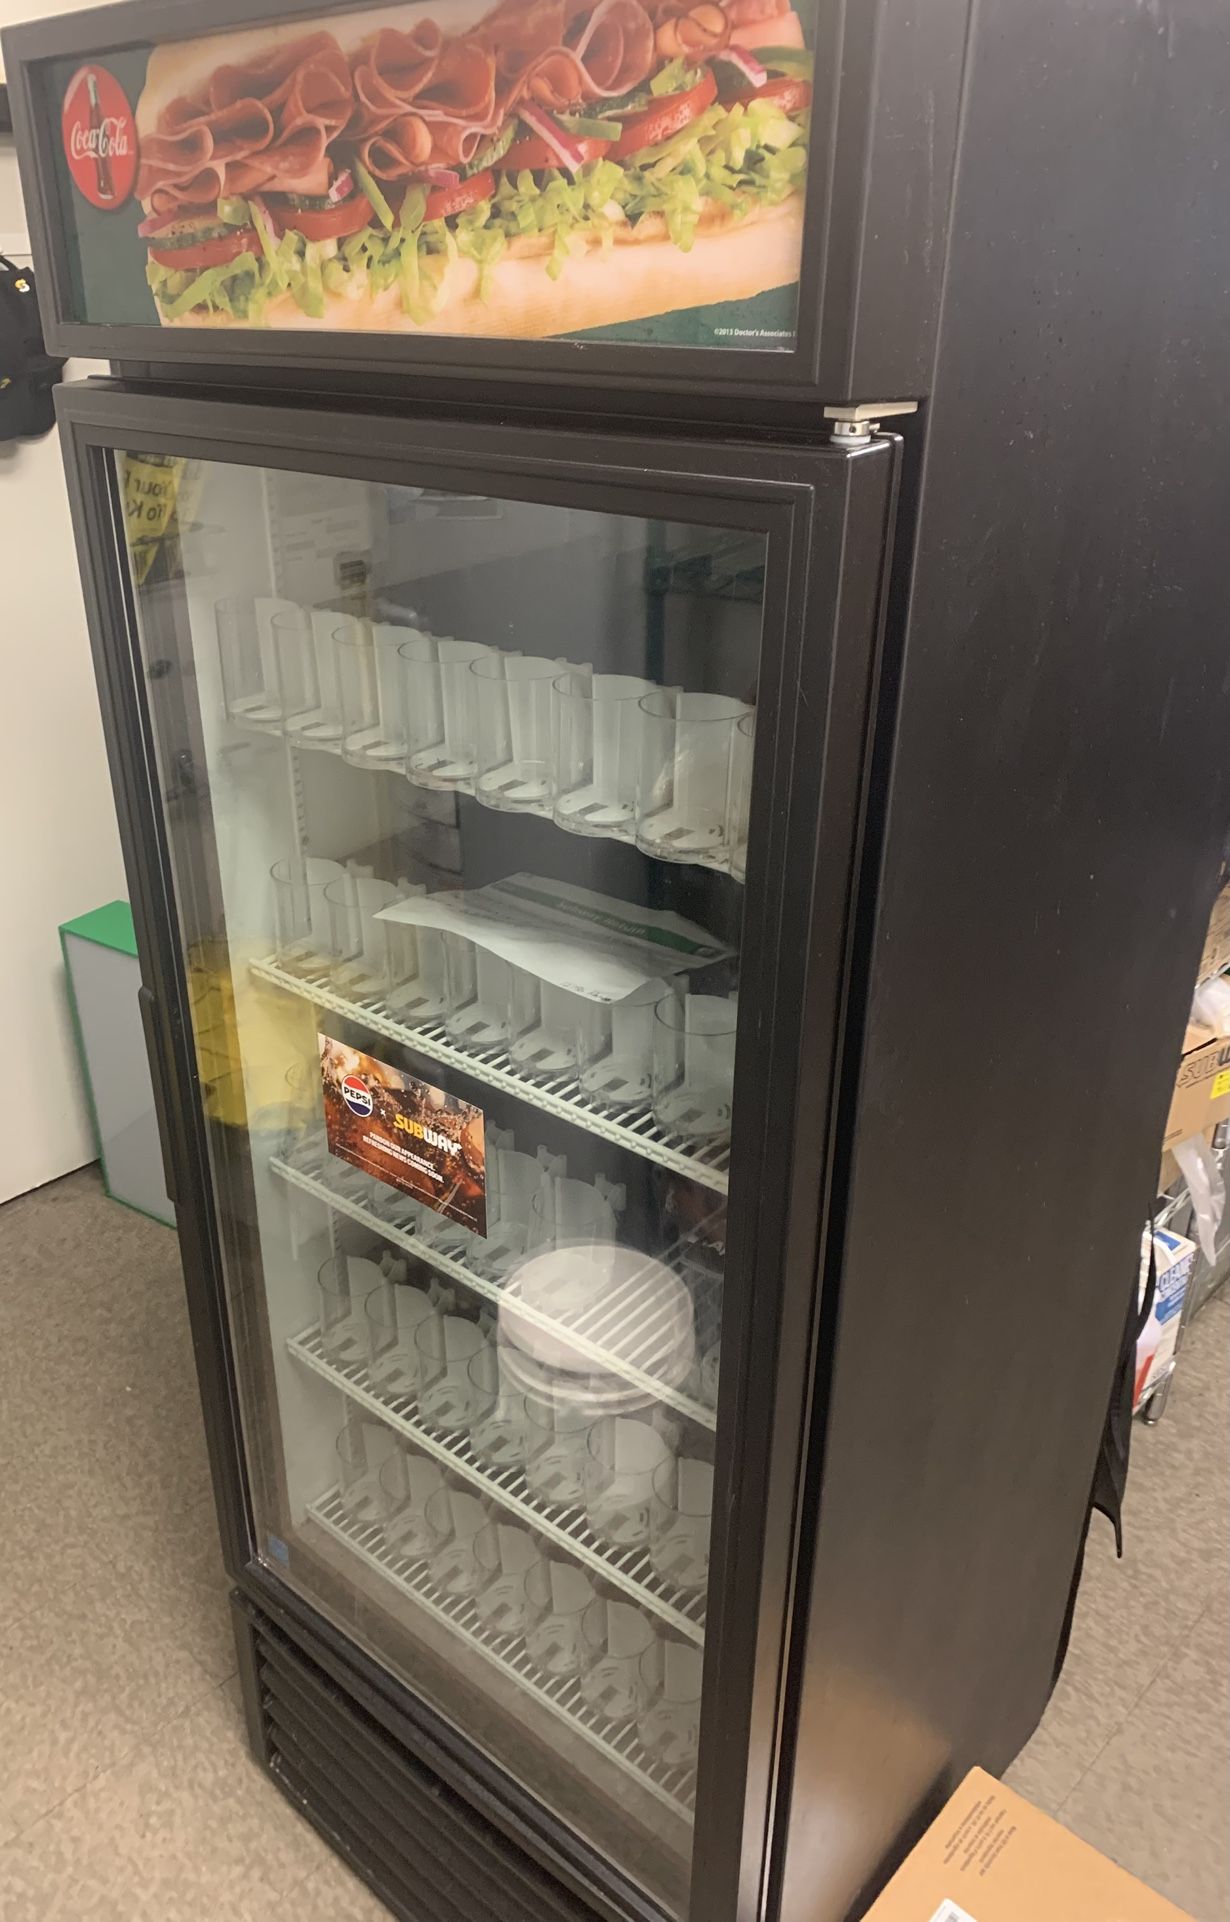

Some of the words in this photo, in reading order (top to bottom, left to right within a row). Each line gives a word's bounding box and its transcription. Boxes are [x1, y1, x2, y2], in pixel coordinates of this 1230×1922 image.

[70, 116, 129, 160] Coca-Cola
[734, 327, 759, 337] Doctor's
[760, 329, 792, 338] Associates
[343, 1085, 371, 1107] PEPSI
[393, 1113, 462, 1156] SUBWAY
